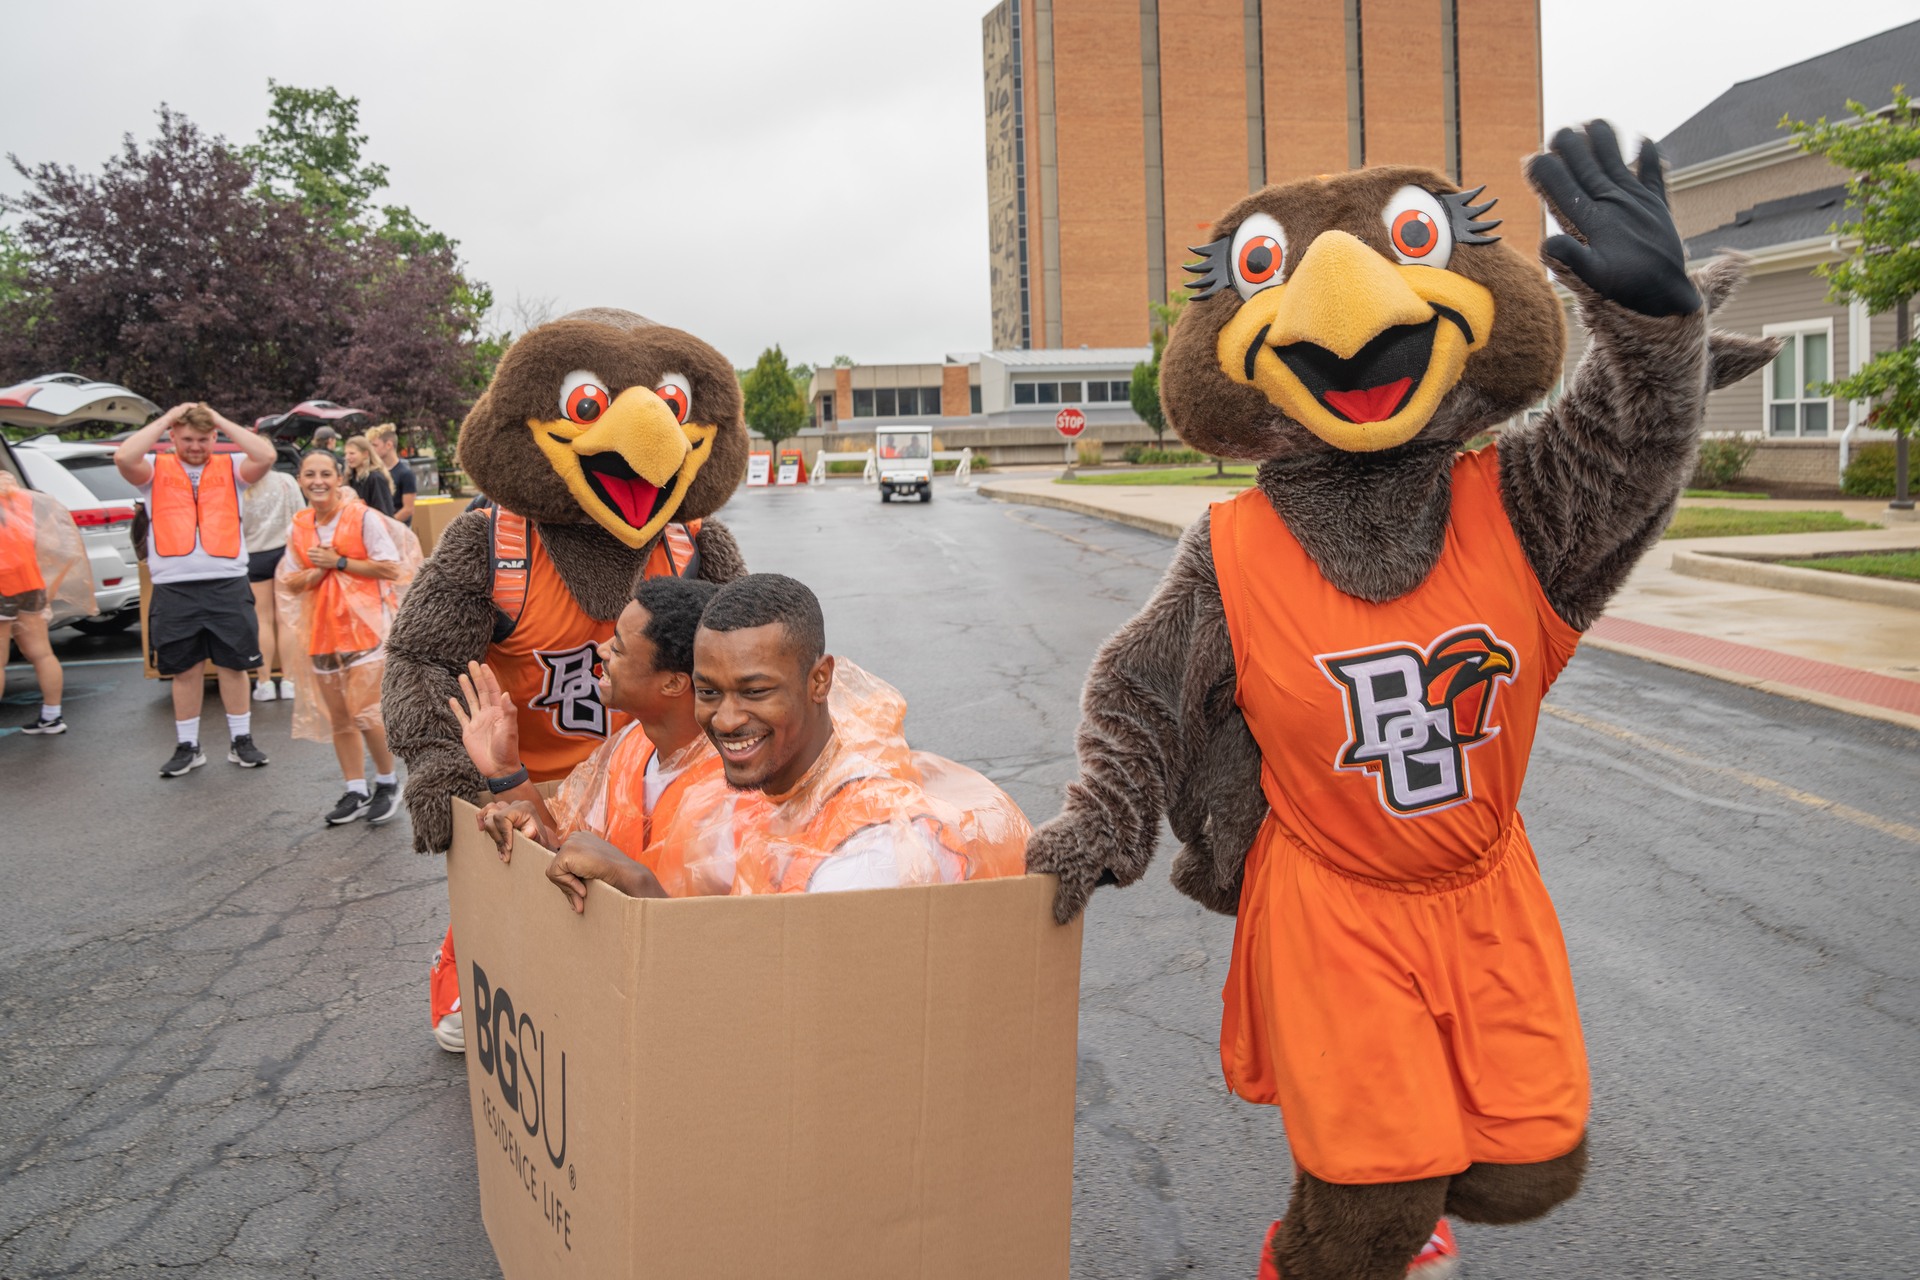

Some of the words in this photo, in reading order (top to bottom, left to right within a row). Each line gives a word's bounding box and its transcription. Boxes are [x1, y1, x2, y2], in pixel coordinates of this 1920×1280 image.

[1058, 415, 1084, 429] STOP
[482, 1087, 538, 1203] RESIDENCE
[543, 1180, 572, 1252] LIFE
